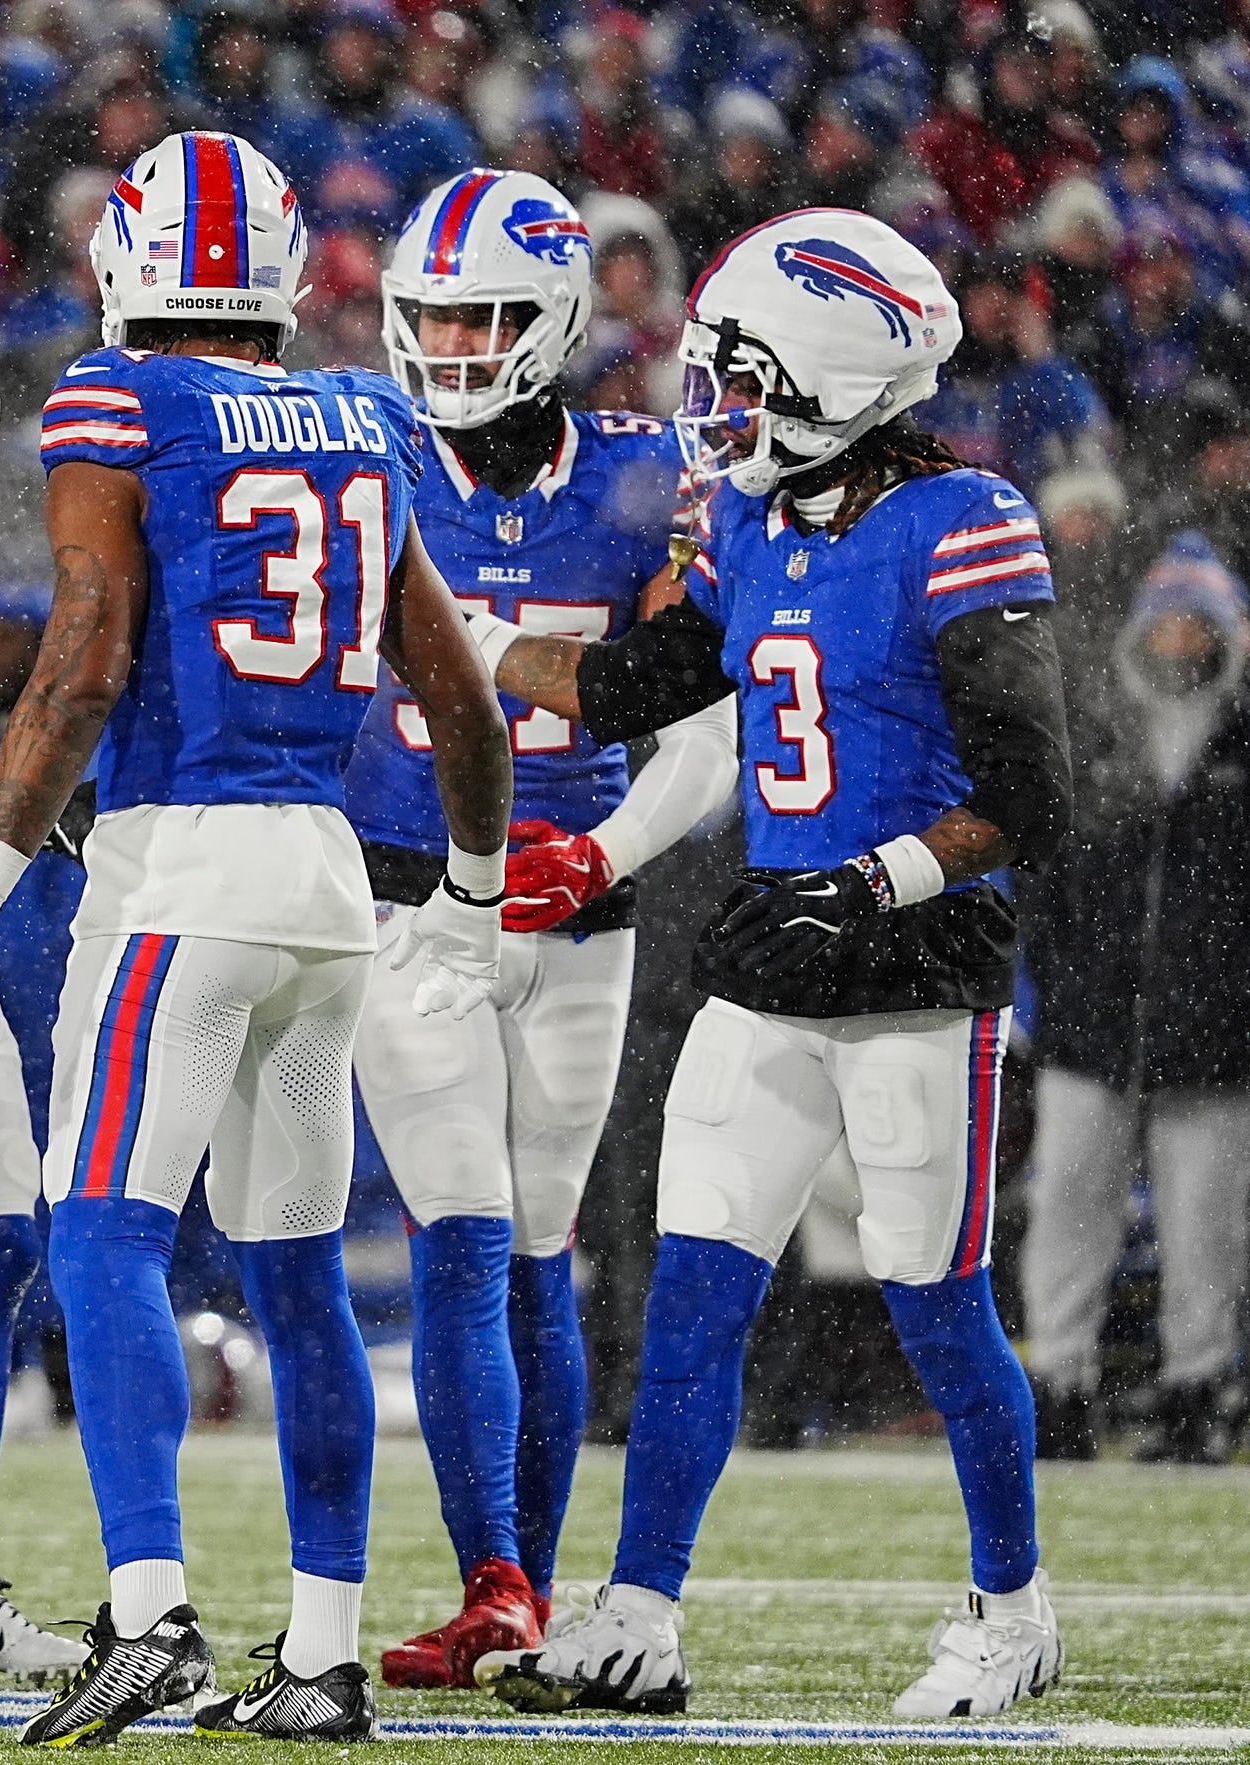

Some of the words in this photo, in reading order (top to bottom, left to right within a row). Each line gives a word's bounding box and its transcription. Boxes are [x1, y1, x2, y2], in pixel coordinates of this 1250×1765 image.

[166, 298, 224, 309] CHOOSE
[228, 299, 262, 311] LOVE
[210, 393, 388, 454] DOUGLAS
[212, 468, 389, 692] 31
[477, 566, 532, 584] BILLS
[771, 609, 812, 626] BILLS
[393, 593, 614, 755] 7
[748, 634, 836, 815] 3
[152, 1621, 188, 1639] NIKE
